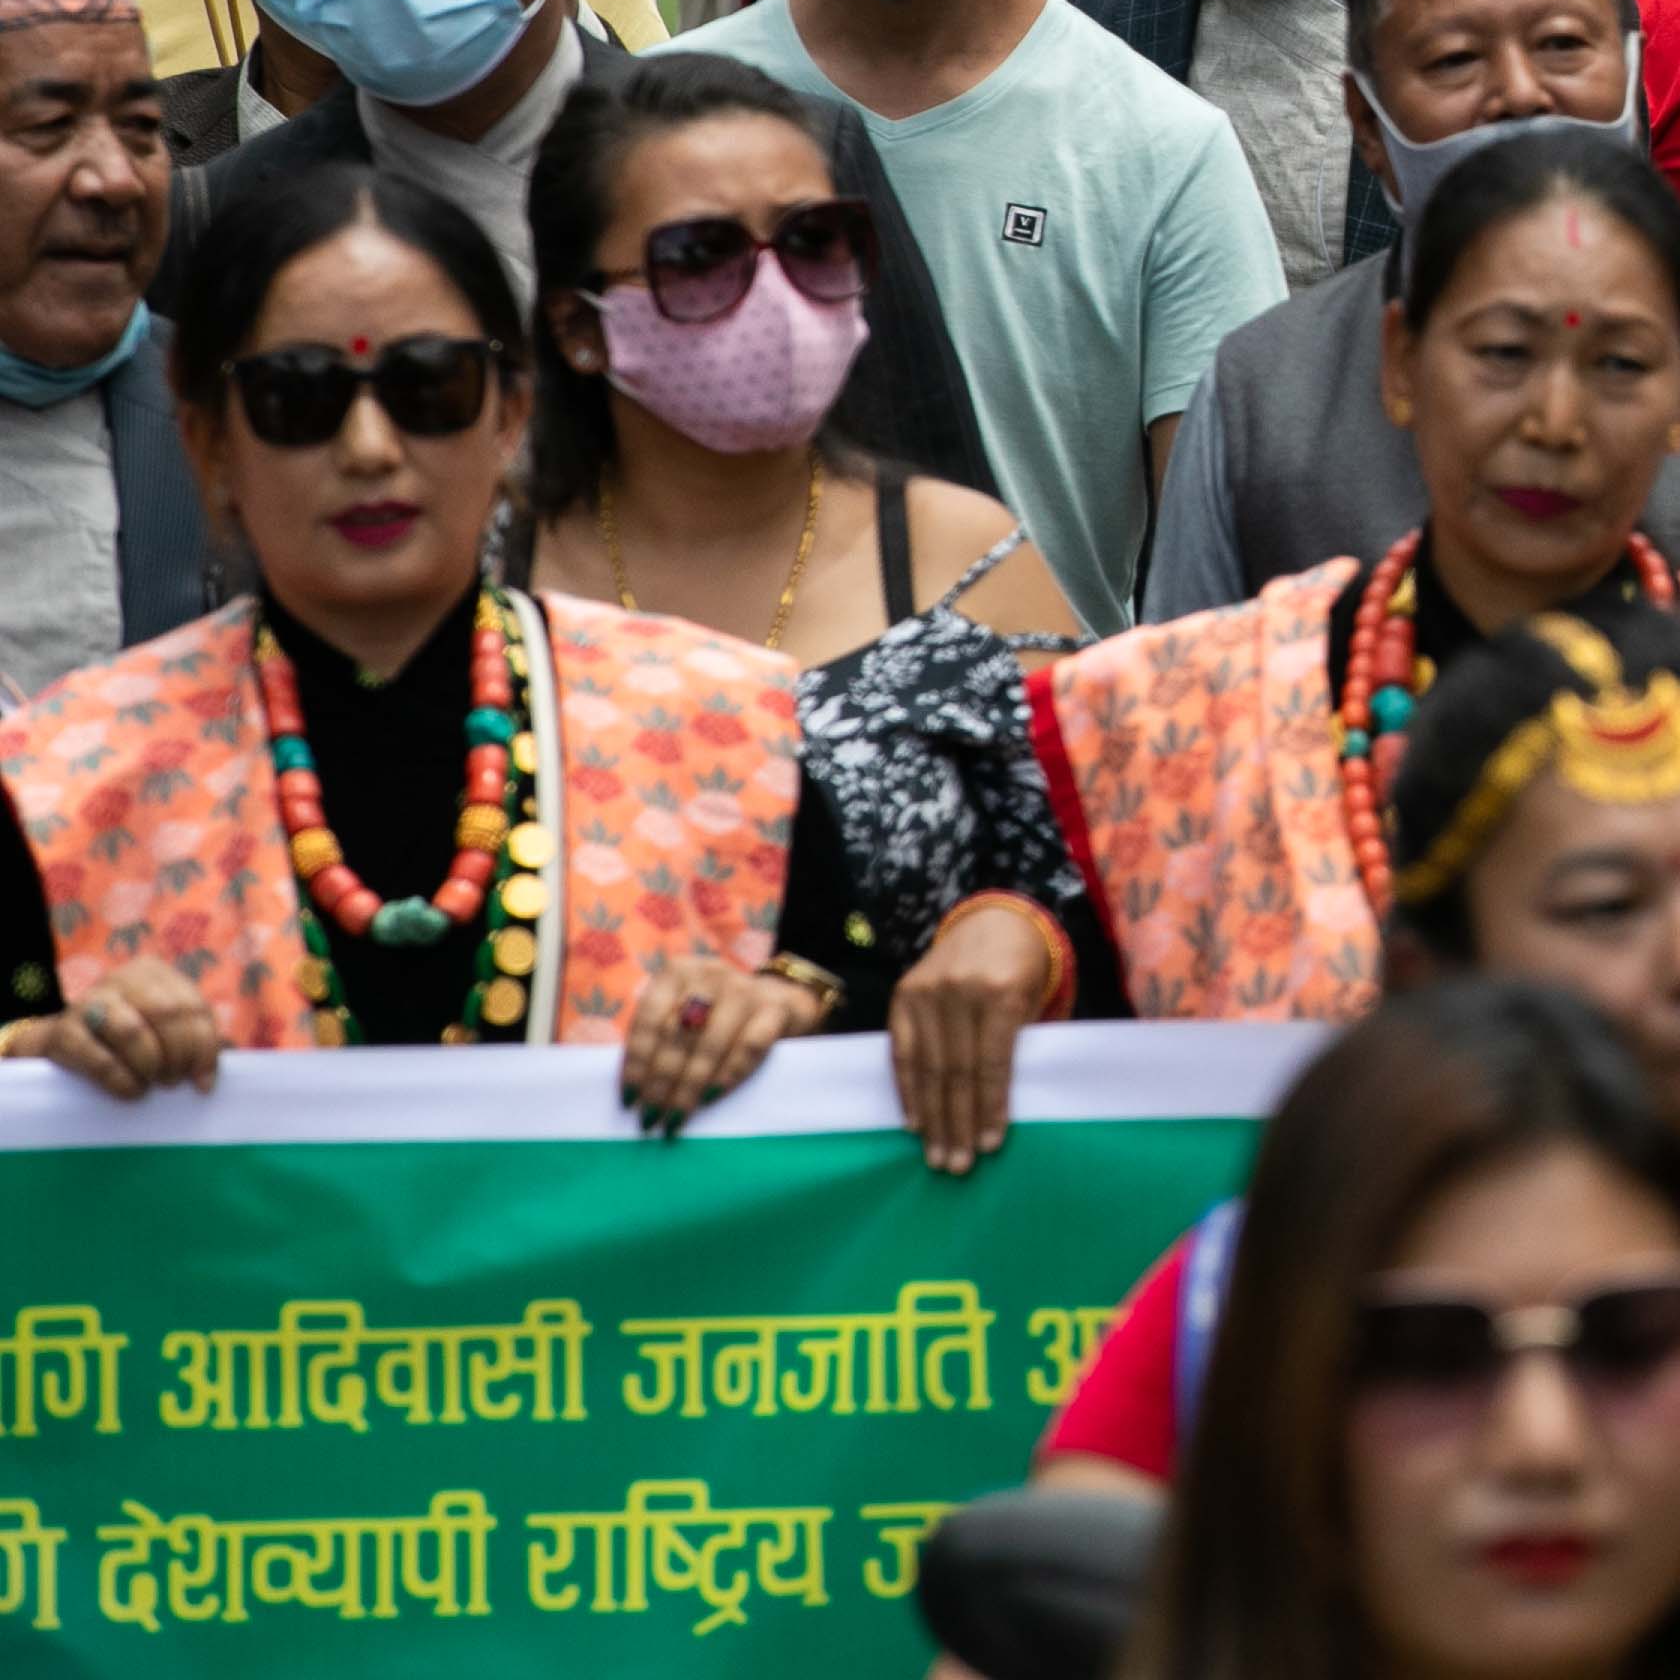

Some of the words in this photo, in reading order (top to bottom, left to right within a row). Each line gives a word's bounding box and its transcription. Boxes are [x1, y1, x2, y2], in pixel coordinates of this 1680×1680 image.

[158, 1298, 594, 1434] आदिवासी
[618, 1279, 996, 1418] जनजाति
[96, 1488, 499, 1634] देशव्यापी
[525, 1478, 834, 1637] राष्ट्रिय
